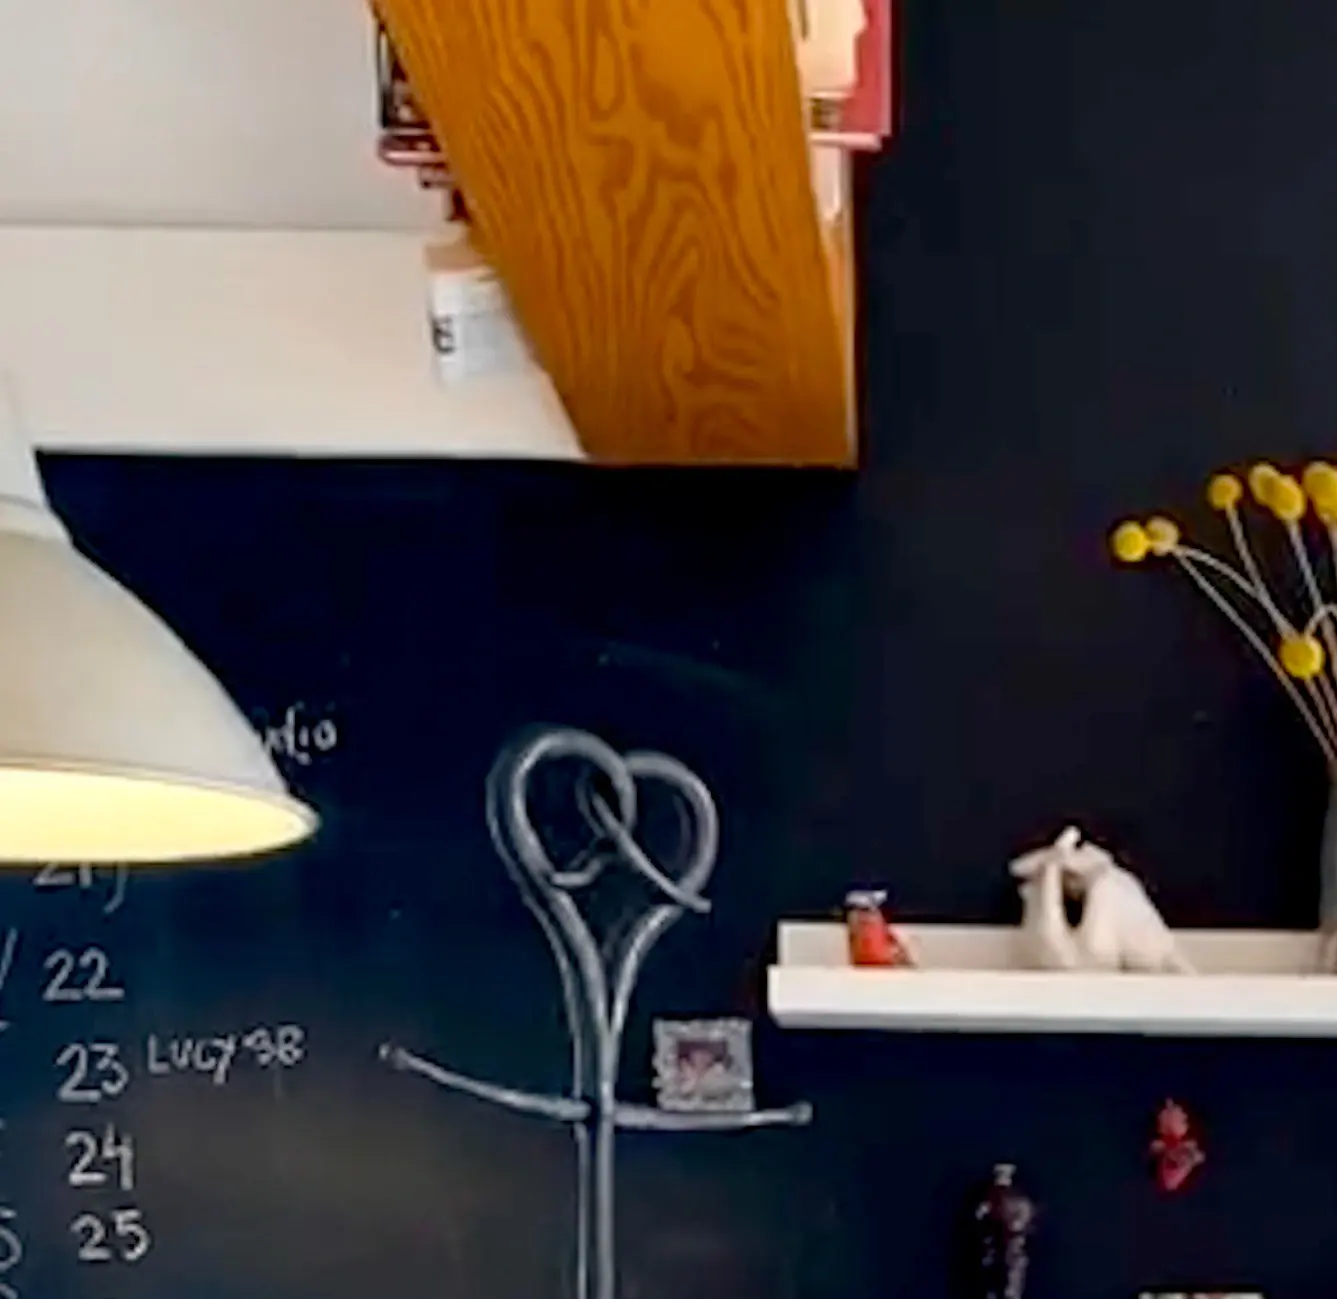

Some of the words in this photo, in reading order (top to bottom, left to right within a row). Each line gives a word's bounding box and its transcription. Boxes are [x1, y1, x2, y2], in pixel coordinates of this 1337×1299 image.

[43, 949, 125, 1000] 22
[56, 1043, 129, 1100] 23
[65, 1122, 134, 1190] 24
[70, 1208, 150, 1261] 25
